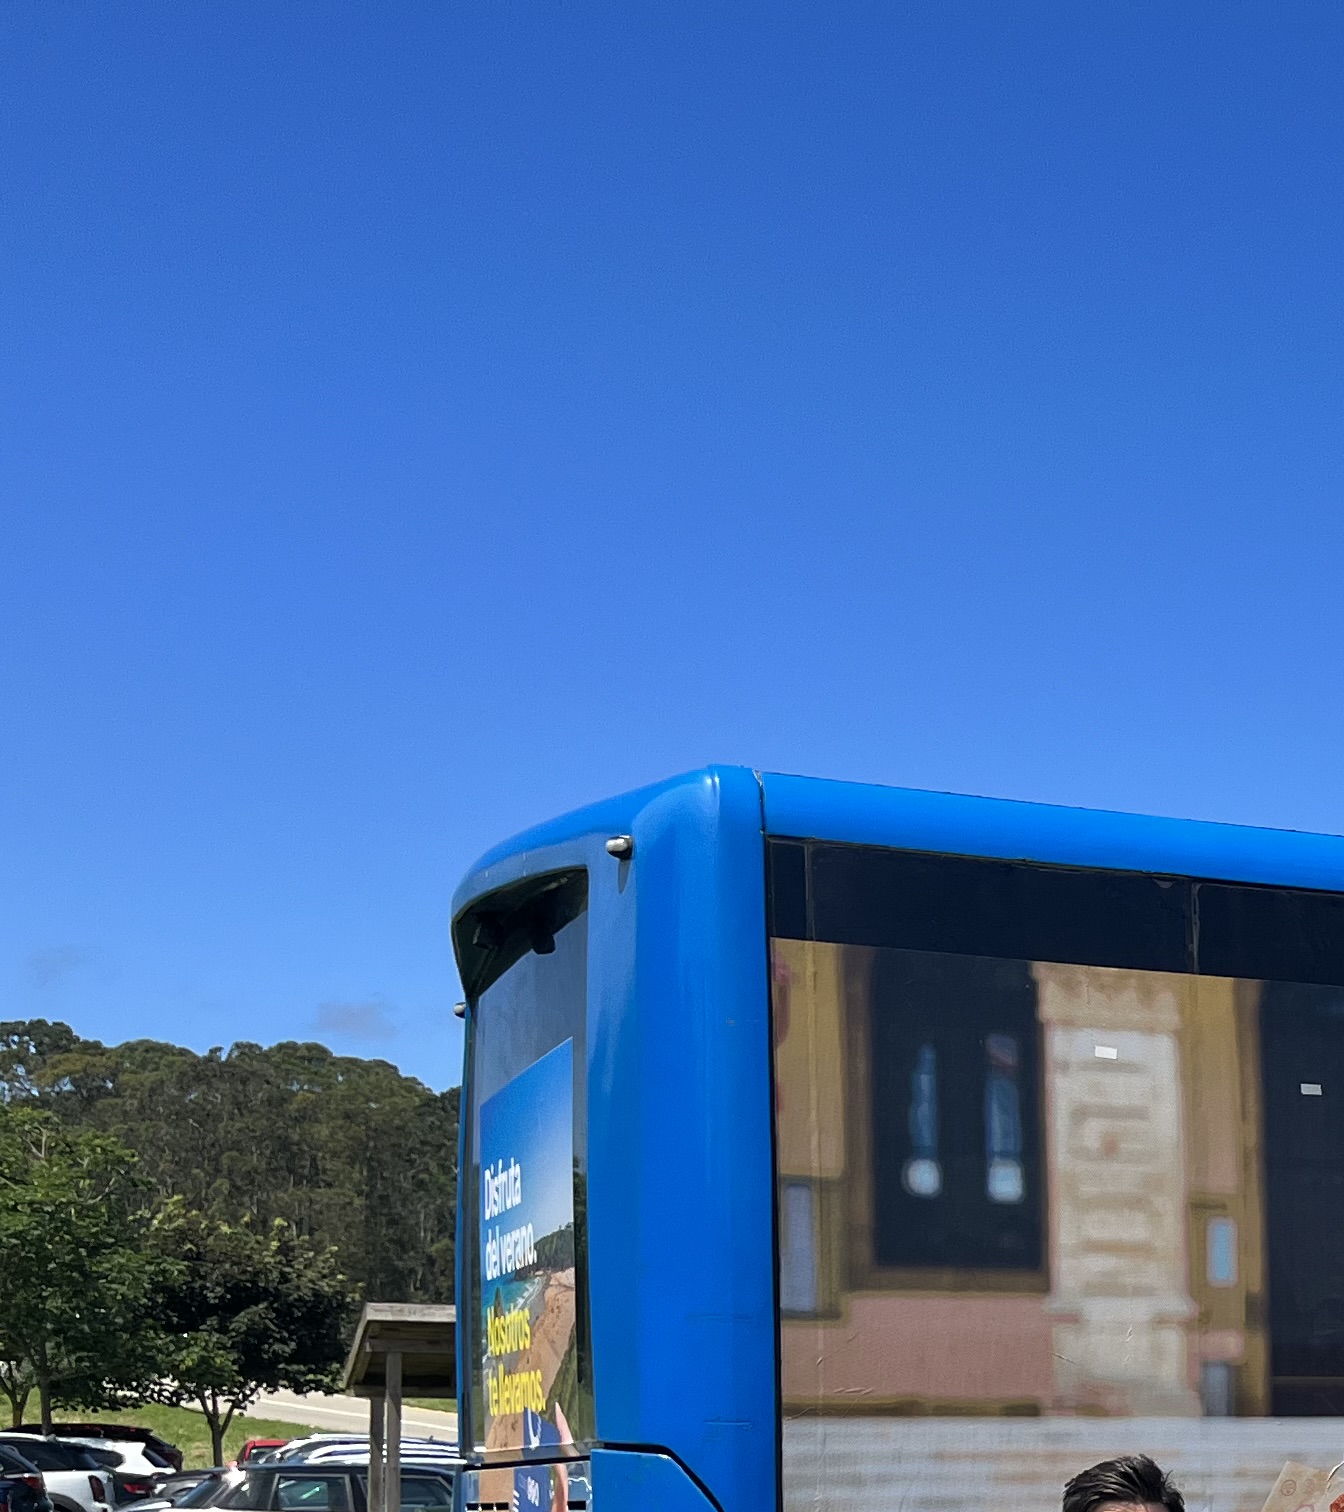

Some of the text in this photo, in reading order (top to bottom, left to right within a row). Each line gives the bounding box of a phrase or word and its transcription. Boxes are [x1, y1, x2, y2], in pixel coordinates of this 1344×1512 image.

[484, 1157, 522, 1221] Disfruta
[485, 1222, 538, 1281] del verano.
[487, 1305, 532, 1357] Nosotros
[488, 1364, 546, 1416] te llevamos.
